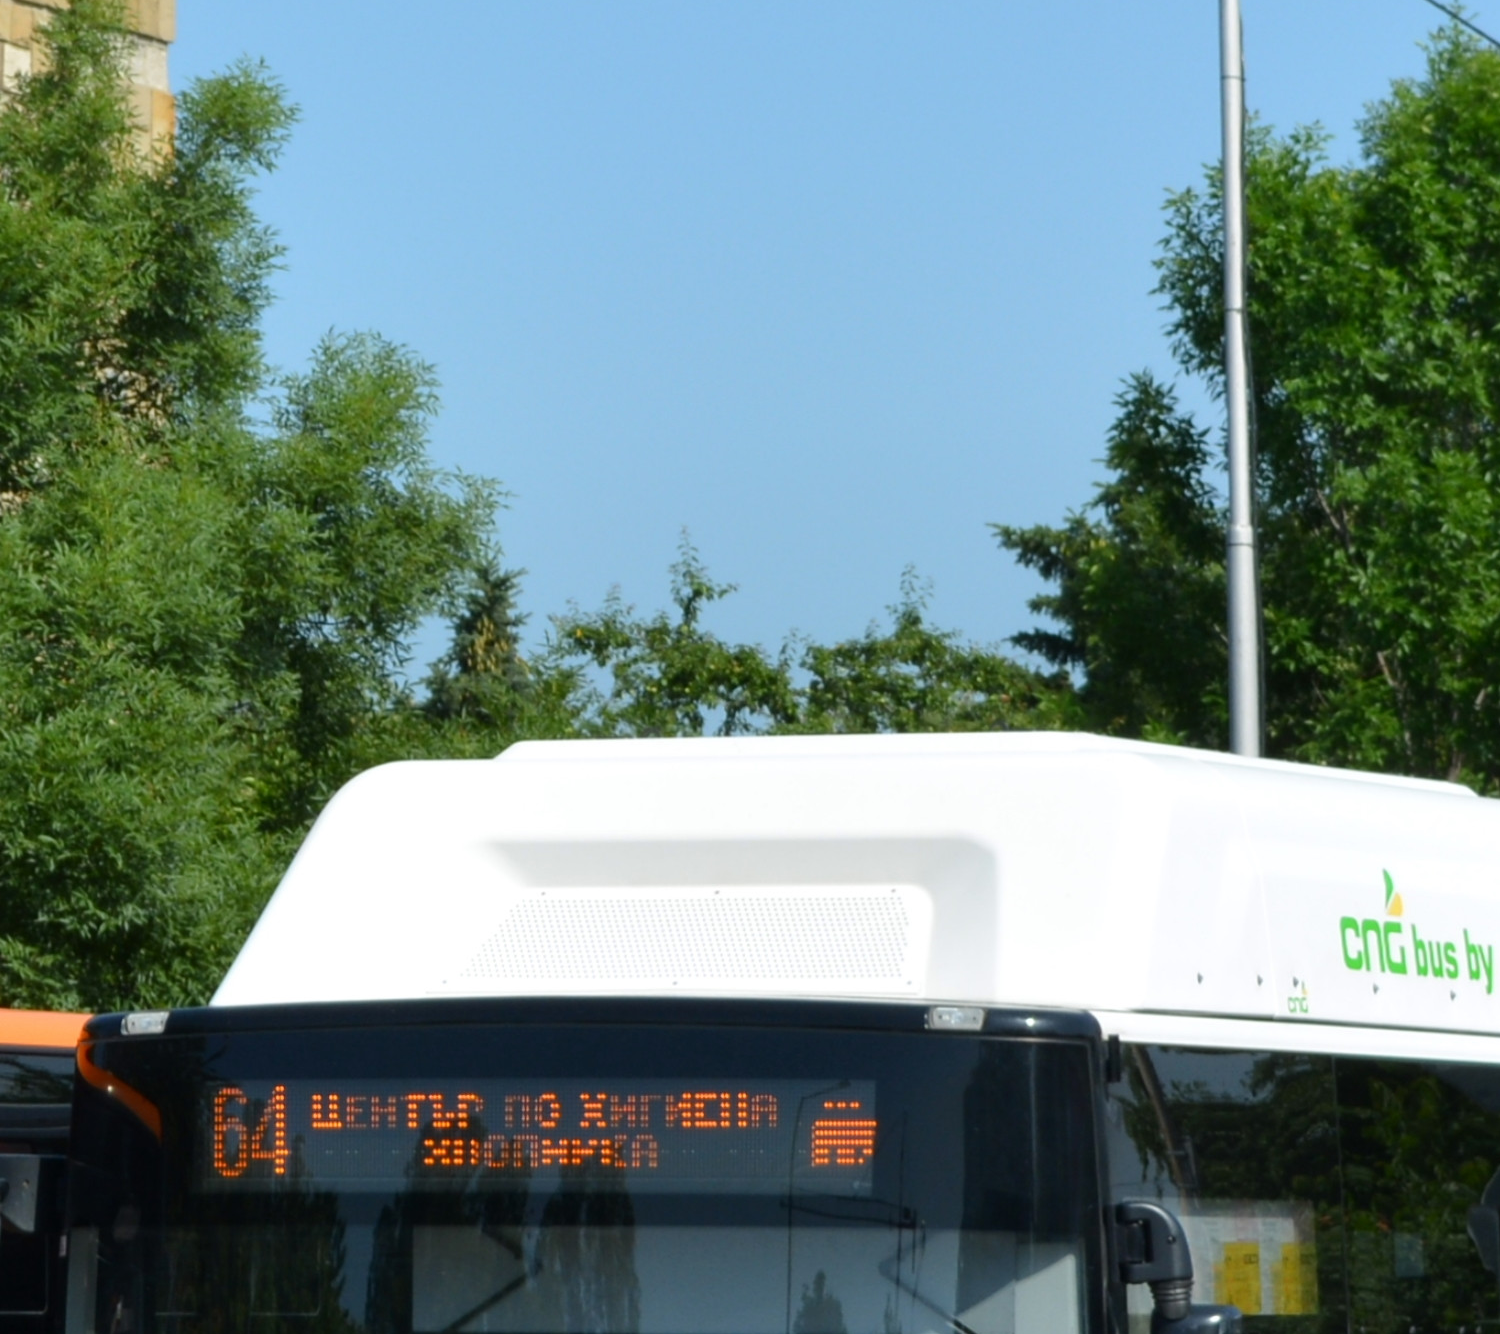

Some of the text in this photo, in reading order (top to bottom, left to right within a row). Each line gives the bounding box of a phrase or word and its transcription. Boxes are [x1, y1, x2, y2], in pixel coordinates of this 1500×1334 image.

[1411, 923, 1460, 979] bus
[1463, 927, 1493, 995] by
[214, 1085, 286, 1178] 64
[504, 1092, 559, 1129] ПО
